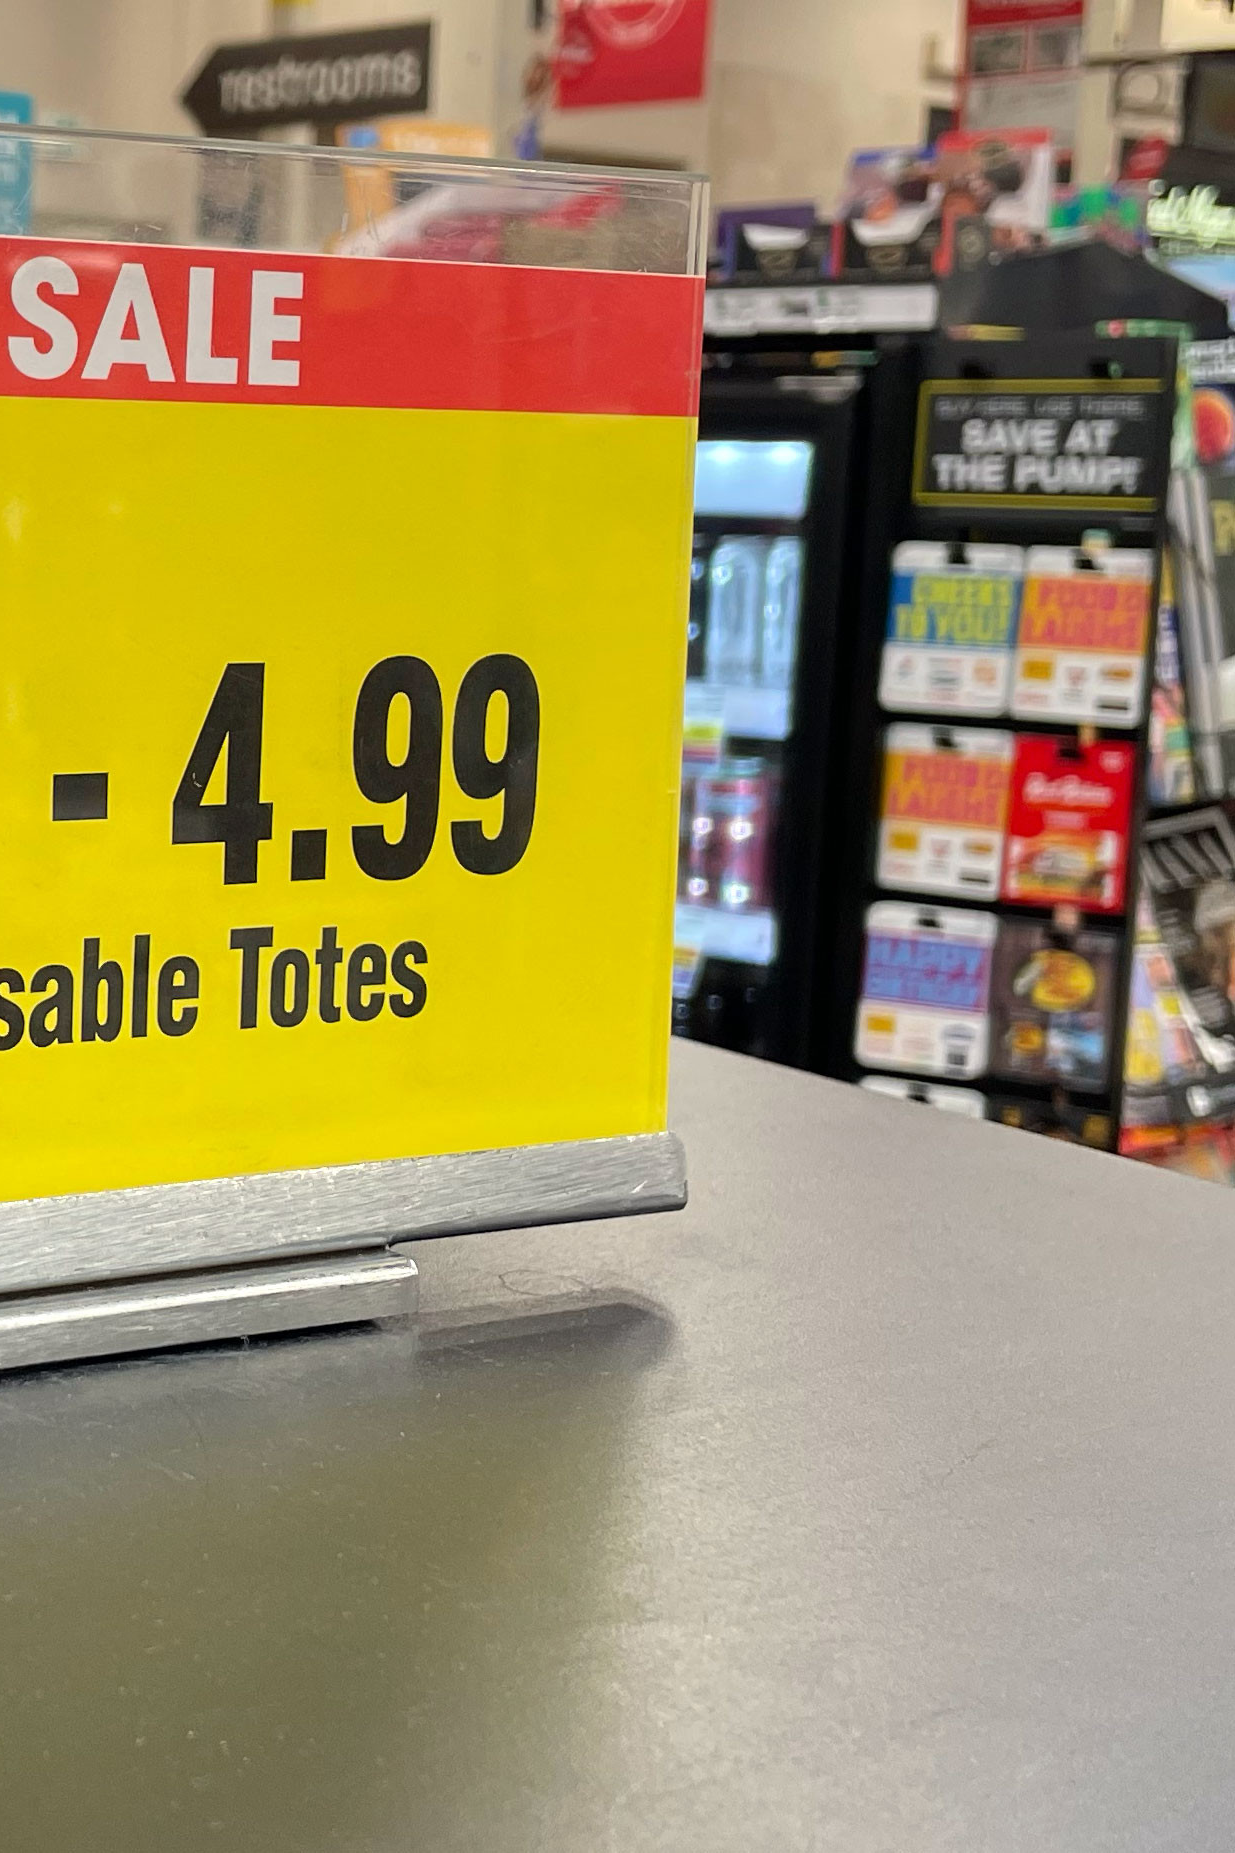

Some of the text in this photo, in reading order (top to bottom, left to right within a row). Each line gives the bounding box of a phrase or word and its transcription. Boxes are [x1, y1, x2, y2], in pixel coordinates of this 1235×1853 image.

[220, 51, 422, 112] restrooms
[7, 256, 304, 387] SALE
[932, 453, 1142, 495] THE PUMP!
[961, 418, 1119, 455] SAVE AT
[171, 653, 541, 885] 4.99
[230, 926, 428, 1029] Totes
